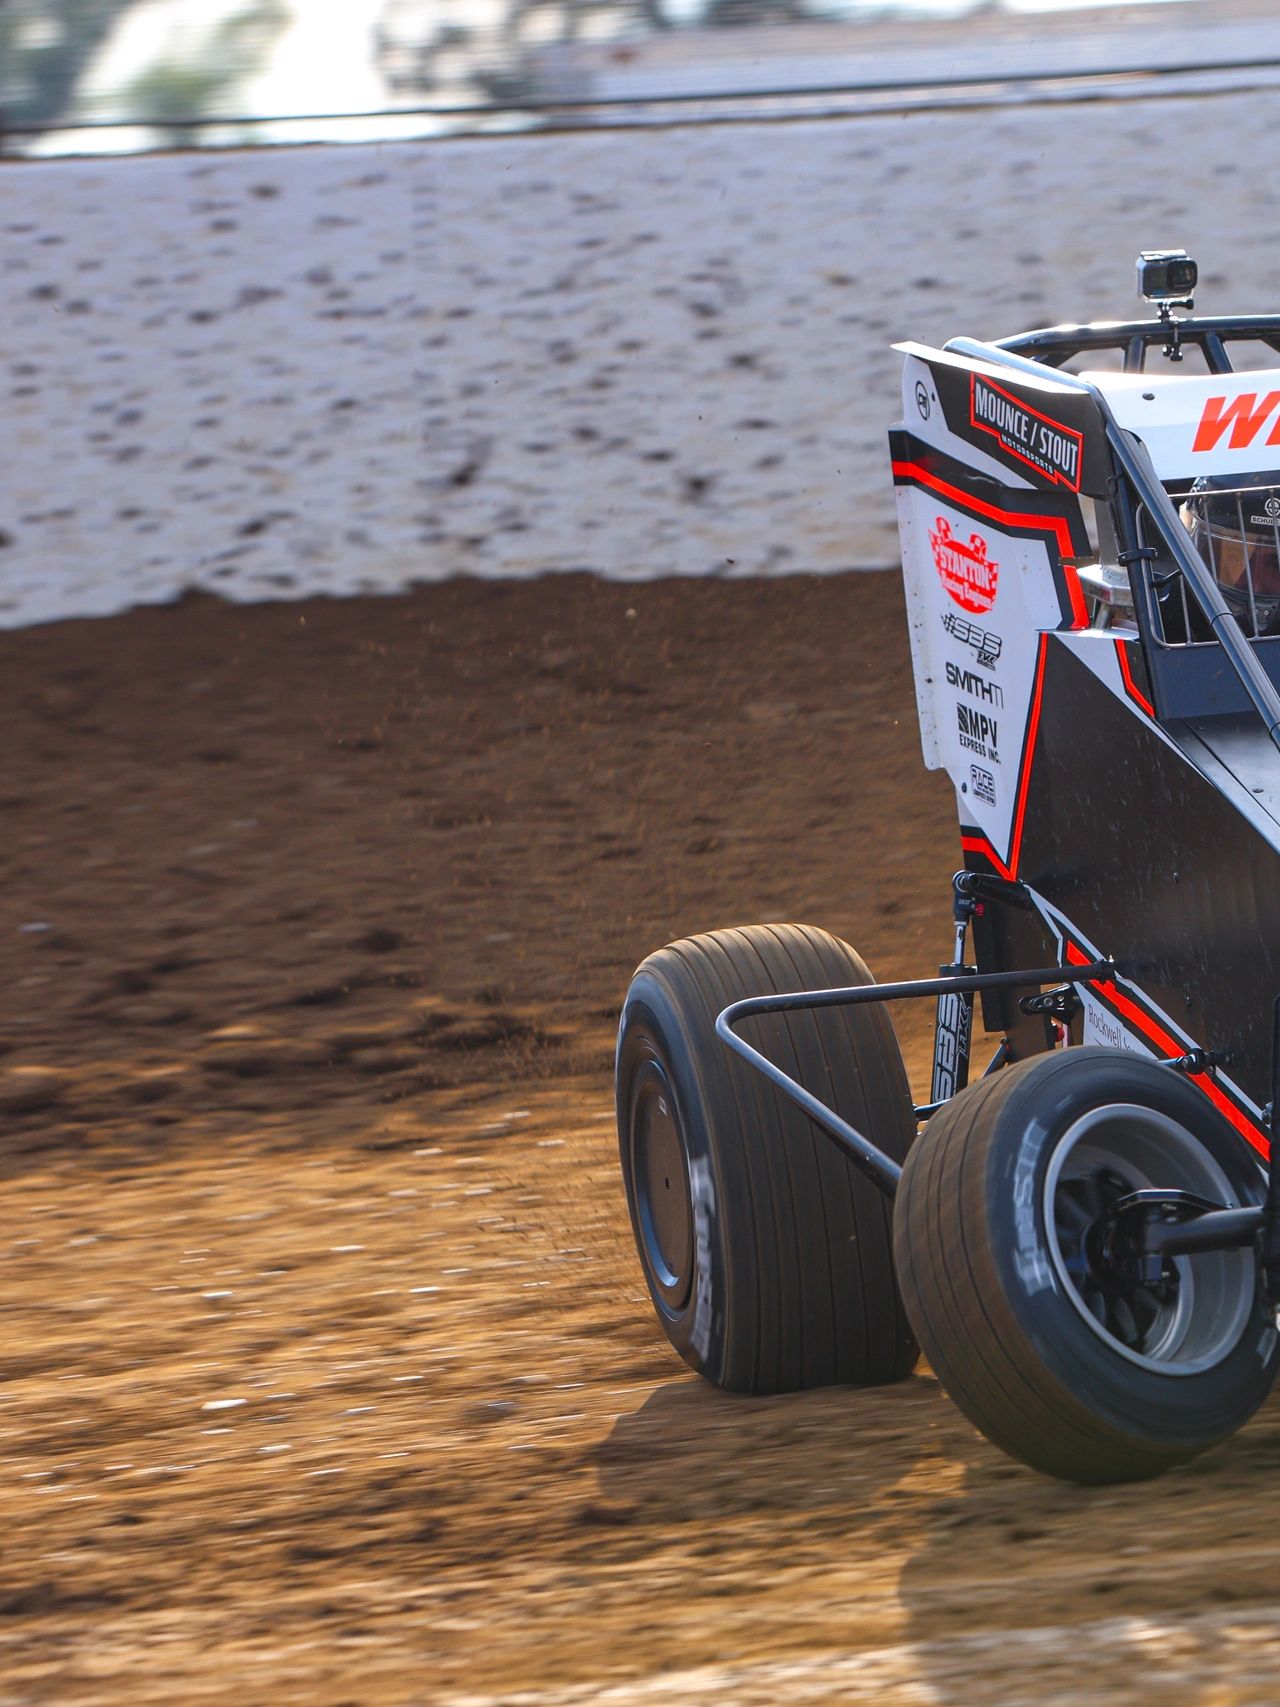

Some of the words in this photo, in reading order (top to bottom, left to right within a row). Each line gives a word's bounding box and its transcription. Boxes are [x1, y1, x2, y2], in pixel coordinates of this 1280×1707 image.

[975, 382, 1028, 443] MOUNCE
[1039, 427, 1078, 476] STOUT
[1001, 434, 1054, 474] MOTORSPORTS
[940, 546, 991, 590] STANTON
[954, 617, 1003, 658] SBS
[959, 733, 987, 757] EXPRESS
[969, 707, 998, 748] MPV
